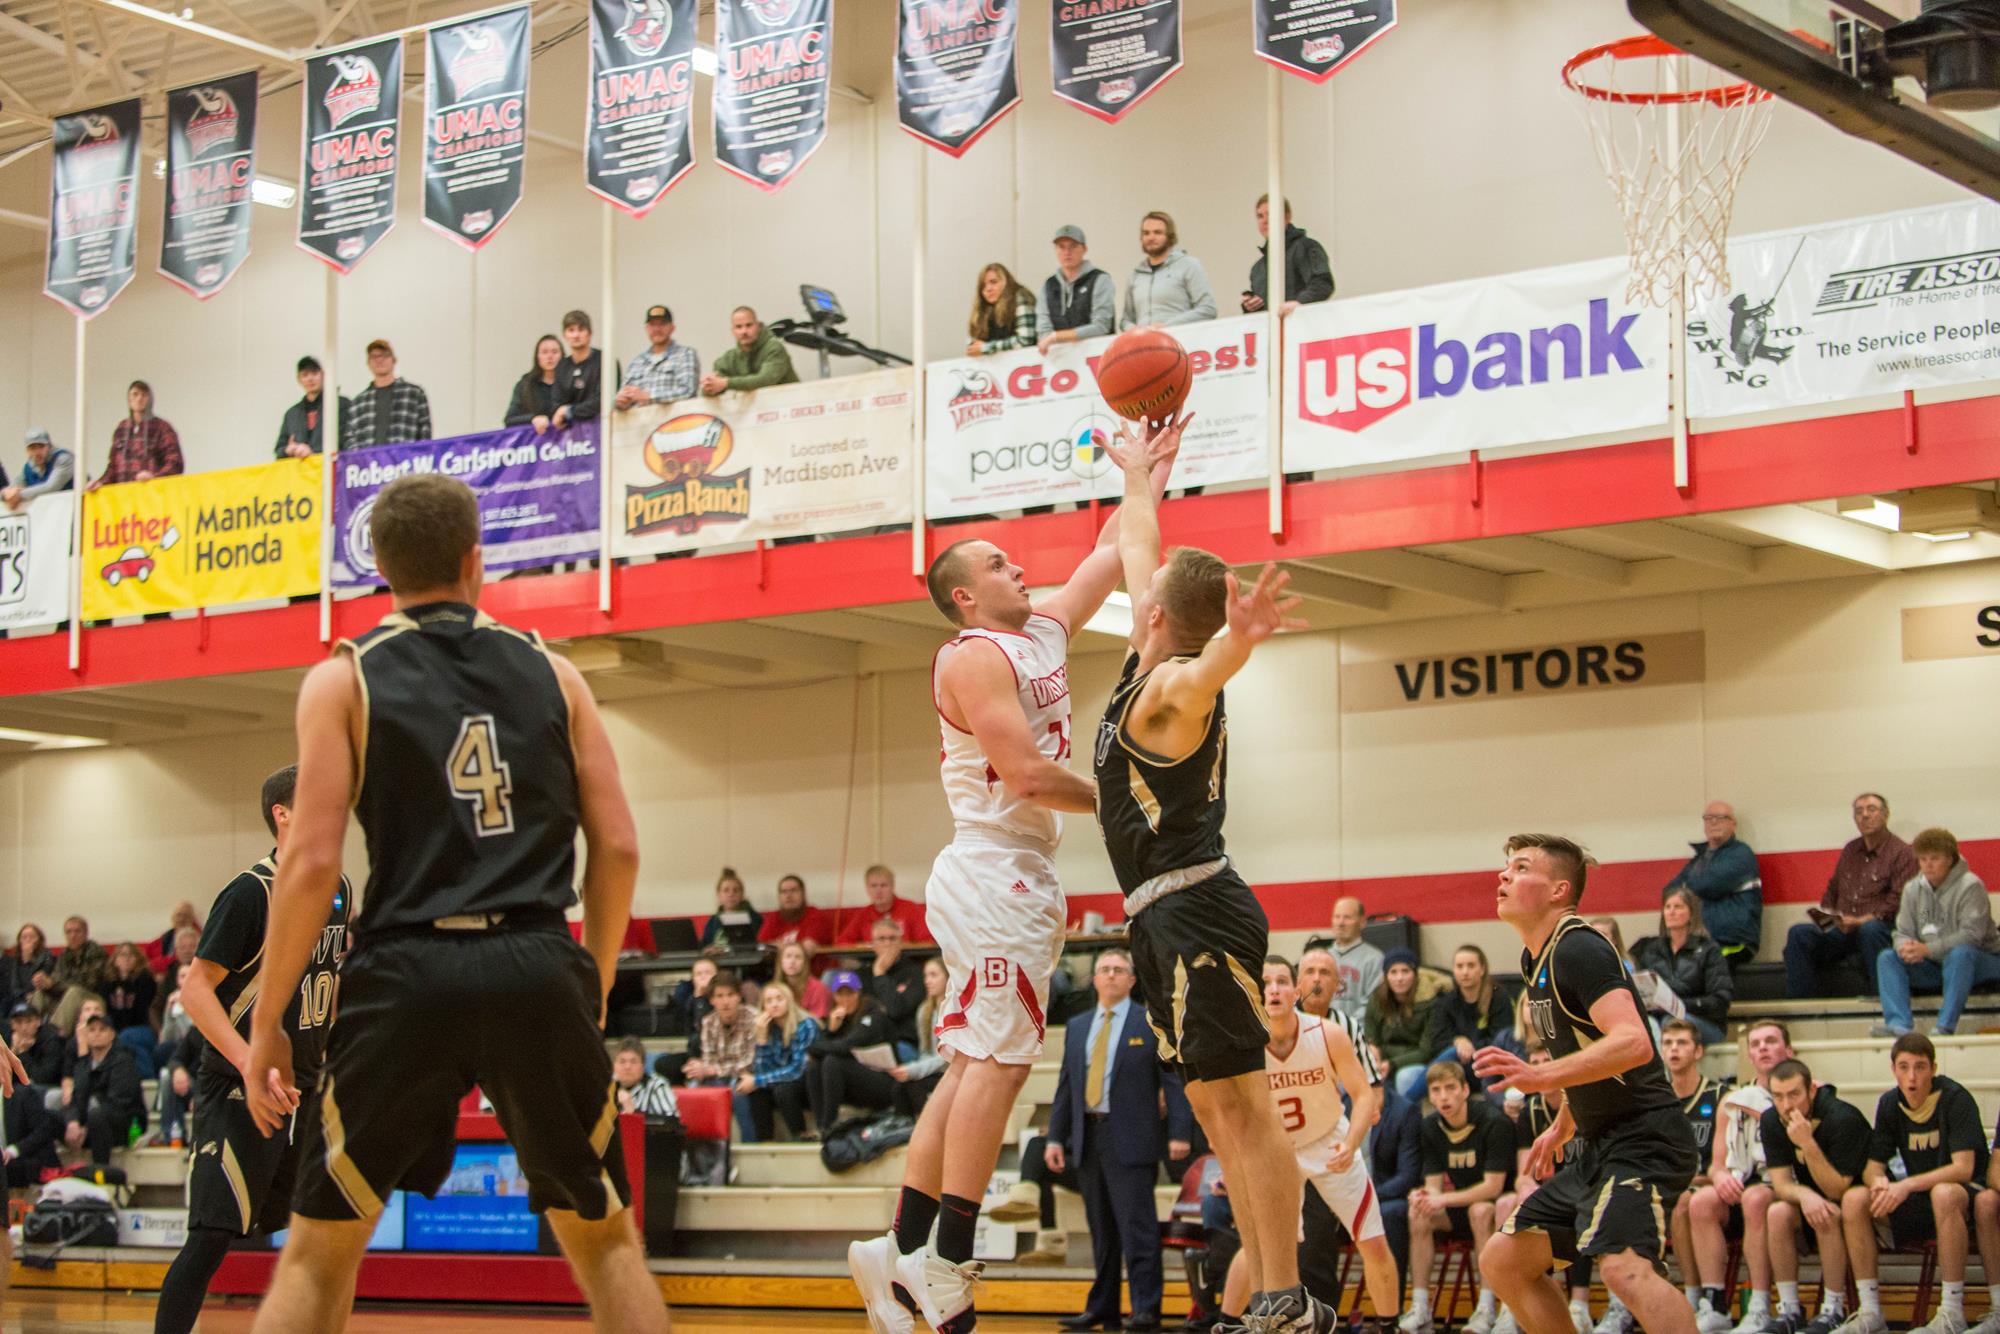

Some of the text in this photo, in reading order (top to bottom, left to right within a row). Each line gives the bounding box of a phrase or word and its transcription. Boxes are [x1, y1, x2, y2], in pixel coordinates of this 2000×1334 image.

[728, 31, 824, 81] UMAC
[599, 61, 691, 108] UMAC
[434, 99, 523, 144] UMAC
[311, 127, 395, 172] UMAC
[172, 157, 250, 201] UMAC
[1842, 254, 2000, 302] TIRE ASSO
[1889, 293, 1914, 309] The
[1918, 286, 1961, 304] Home
[1964, 283, 1981, 299] of
[1304, 298, 1645, 417] us bank
[1816, 341, 1851, 359] The
[1857, 328, 1926, 354] Service
[1008, 364, 1080, 399] Go
[951, 403, 1004, 431] VIKINGS
[346, 459, 411, 489] Robert
[413, 455, 438, 476] W.
[439, 444, 536, 475] Carlstrom
[566, 439, 596, 456] Inc.
[791, 438, 849, 458] Located
[763, 455, 899, 486] Madison Ave
[195, 496, 313, 535] Mankato
[685, 477, 749, 515] Ranch
[93, 511, 171, 549] Luther
[195, 533, 282, 573] Honda
[1395, 641, 1646, 701] VISITORS
[446, 714, 515, 837] 4
[984, 957, 1008, 988] B
[299, 971, 334, 1029] 10
[1278, 1097, 1306, 1133] 3
